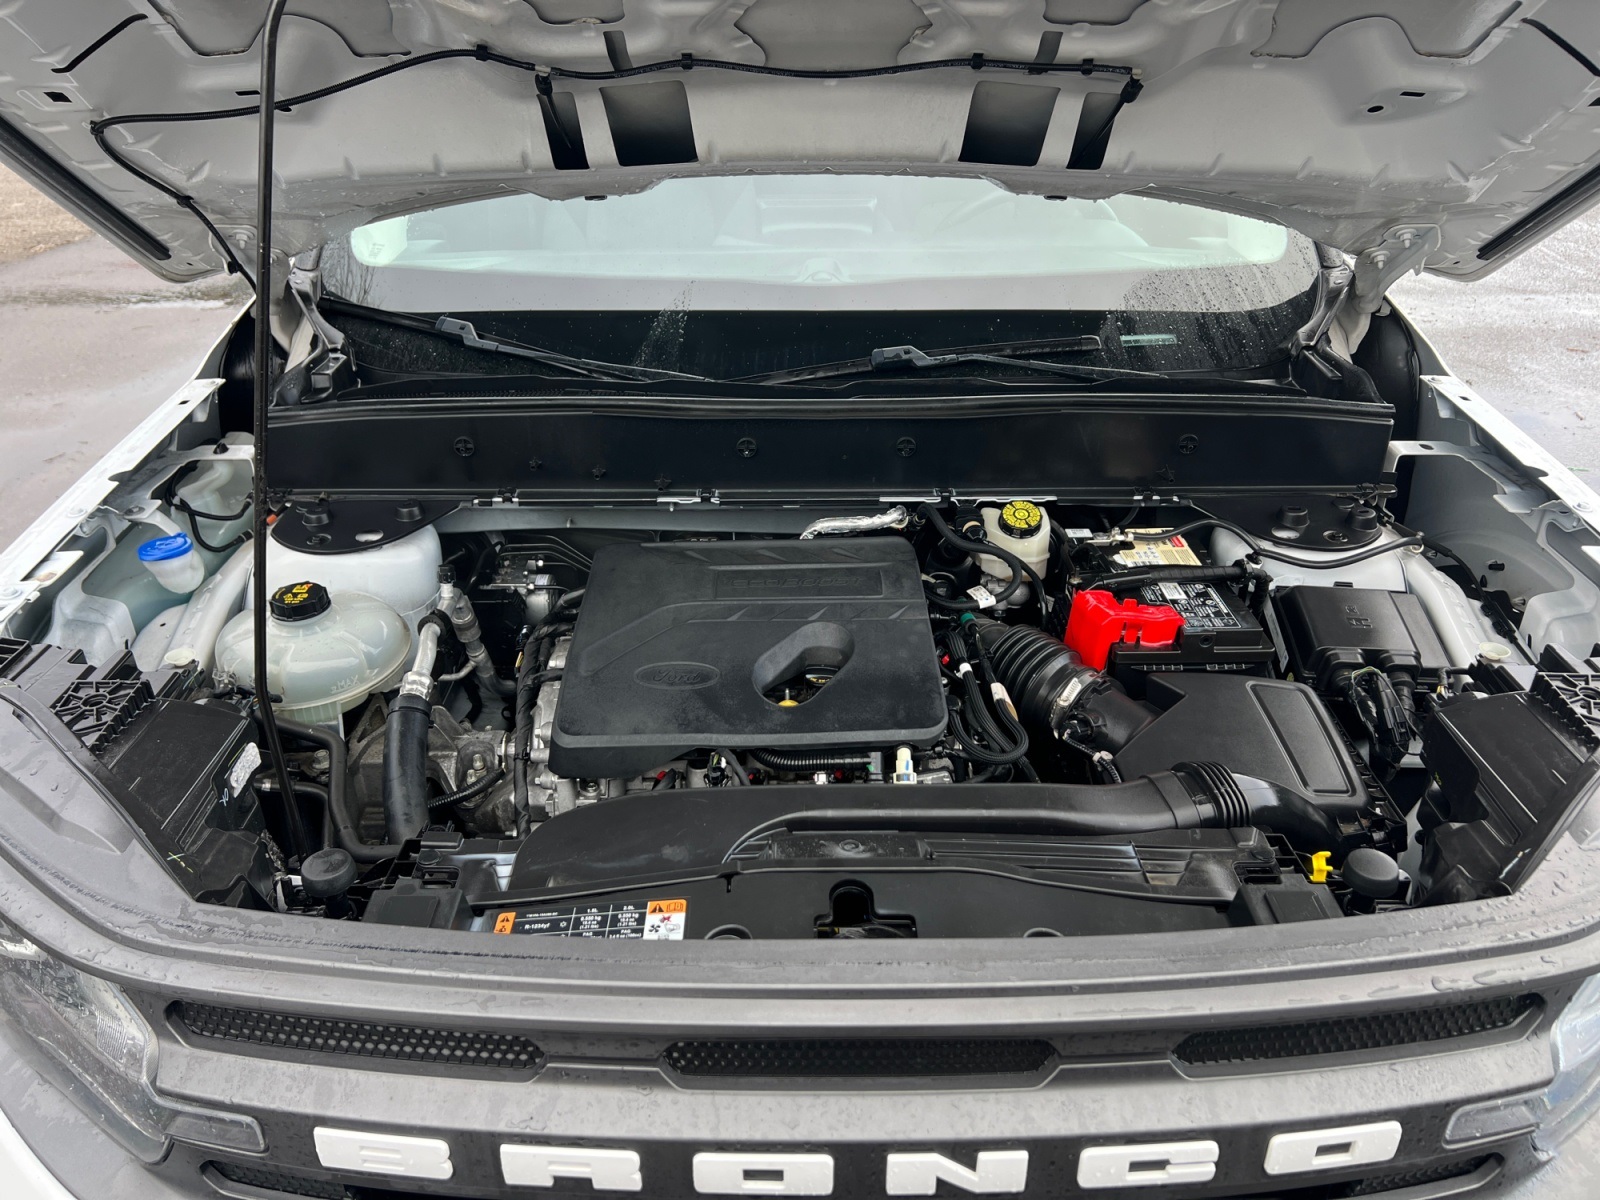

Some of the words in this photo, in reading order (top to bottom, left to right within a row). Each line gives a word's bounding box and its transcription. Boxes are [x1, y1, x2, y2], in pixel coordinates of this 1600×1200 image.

[337, 674, 361, 690] MAX
[652, 667, 701, 686] Ford
[313, 1120, 1403, 1196] BRONCO
